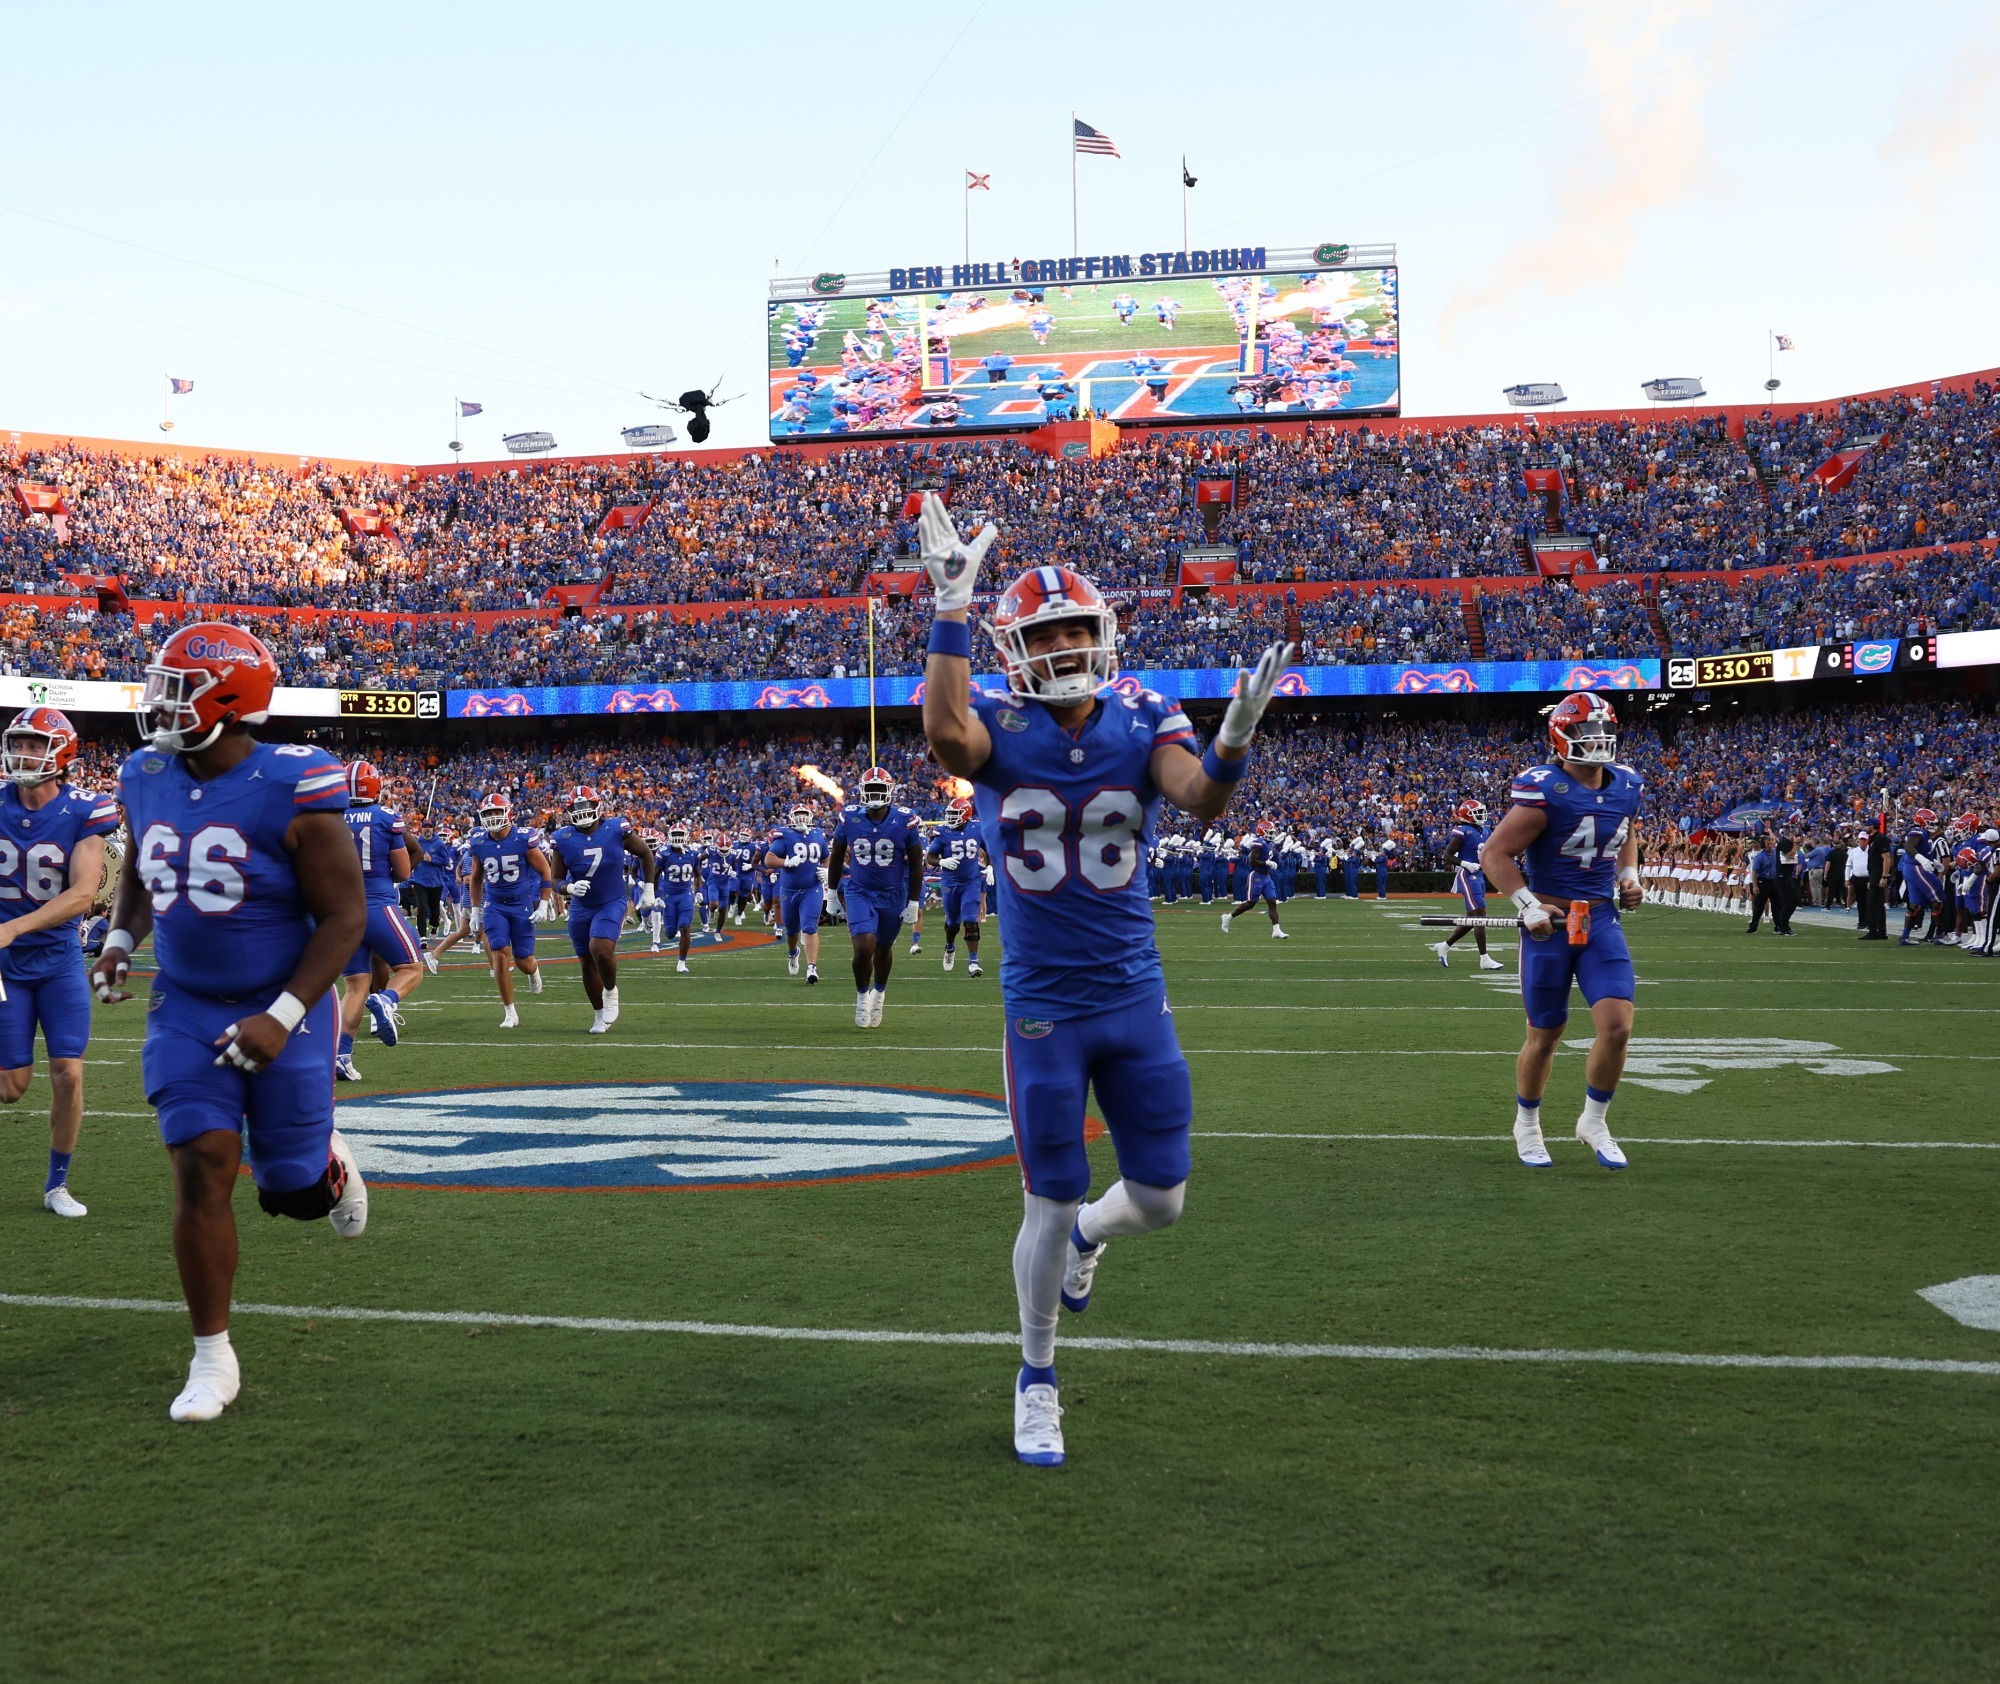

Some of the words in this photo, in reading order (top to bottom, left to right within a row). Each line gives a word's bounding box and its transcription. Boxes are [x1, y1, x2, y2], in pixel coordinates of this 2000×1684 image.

[890, 266, 943, 290] BEN
[953, 262, 1012, 286] HILL
[1021, 255, 1131, 282] GRIFFIN
[1139, 247, 1266, 276] STADIUM
[508, 441, 551, 449] HEISMAN
[1753, 656, 1772, 665] QTR
[1828, 652, 1841, 668] 0
[1910, 645, 1924, 661] 0
[1671, 666, 1695, 682] 25
[1703, 659, 1750, 680] 3:30
[1761, 667, 1766, 676] 1
[348, 703, 353, 711] 1
[365, 696, 411, 713] 3:30
[420, 698, 438, 712] 25
[1001, 786, 1143, 893] 38
[1560, 815, 1630, 869] 44
[951, 839, 978, 860] 56
[0, 839, 65, 901] 26
[138, 823, 249, 914] 66
[583, 848, 603, 878] 7
[668, 863, 694, 883] 20
